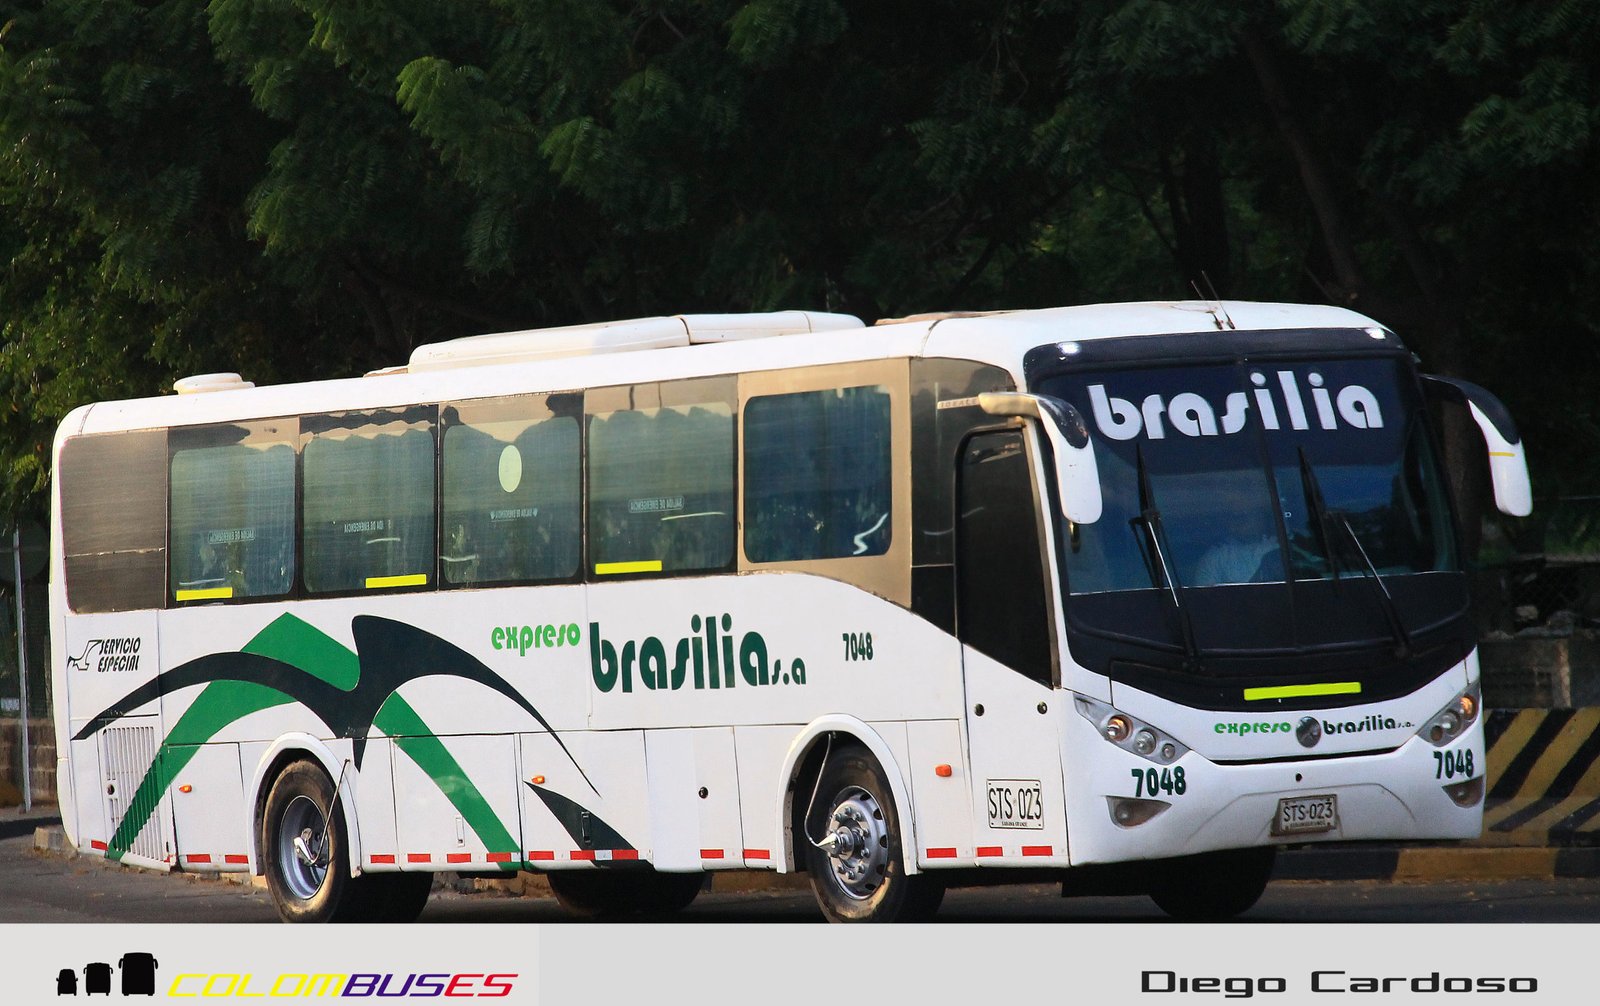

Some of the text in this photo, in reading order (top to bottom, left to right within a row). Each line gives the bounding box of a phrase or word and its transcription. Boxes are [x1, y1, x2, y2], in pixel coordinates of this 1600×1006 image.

[1087, 370, 1384, 440] brasilia
[99, 637, 141, 655] SERVICIO
[491, 623, 581, 657] expreso
[589, 613, 769, 693] brasilia
[842, 632, 874, 662] 7048
[98, 655, 140, 672] ESPECIAL
[1214, 721, 1291, 736] expreso
[1322, 714, 1396, 735] brasilia
[1433, 749, 1474, 779] 7048
[1132, 765, 1187, 798] 7048
